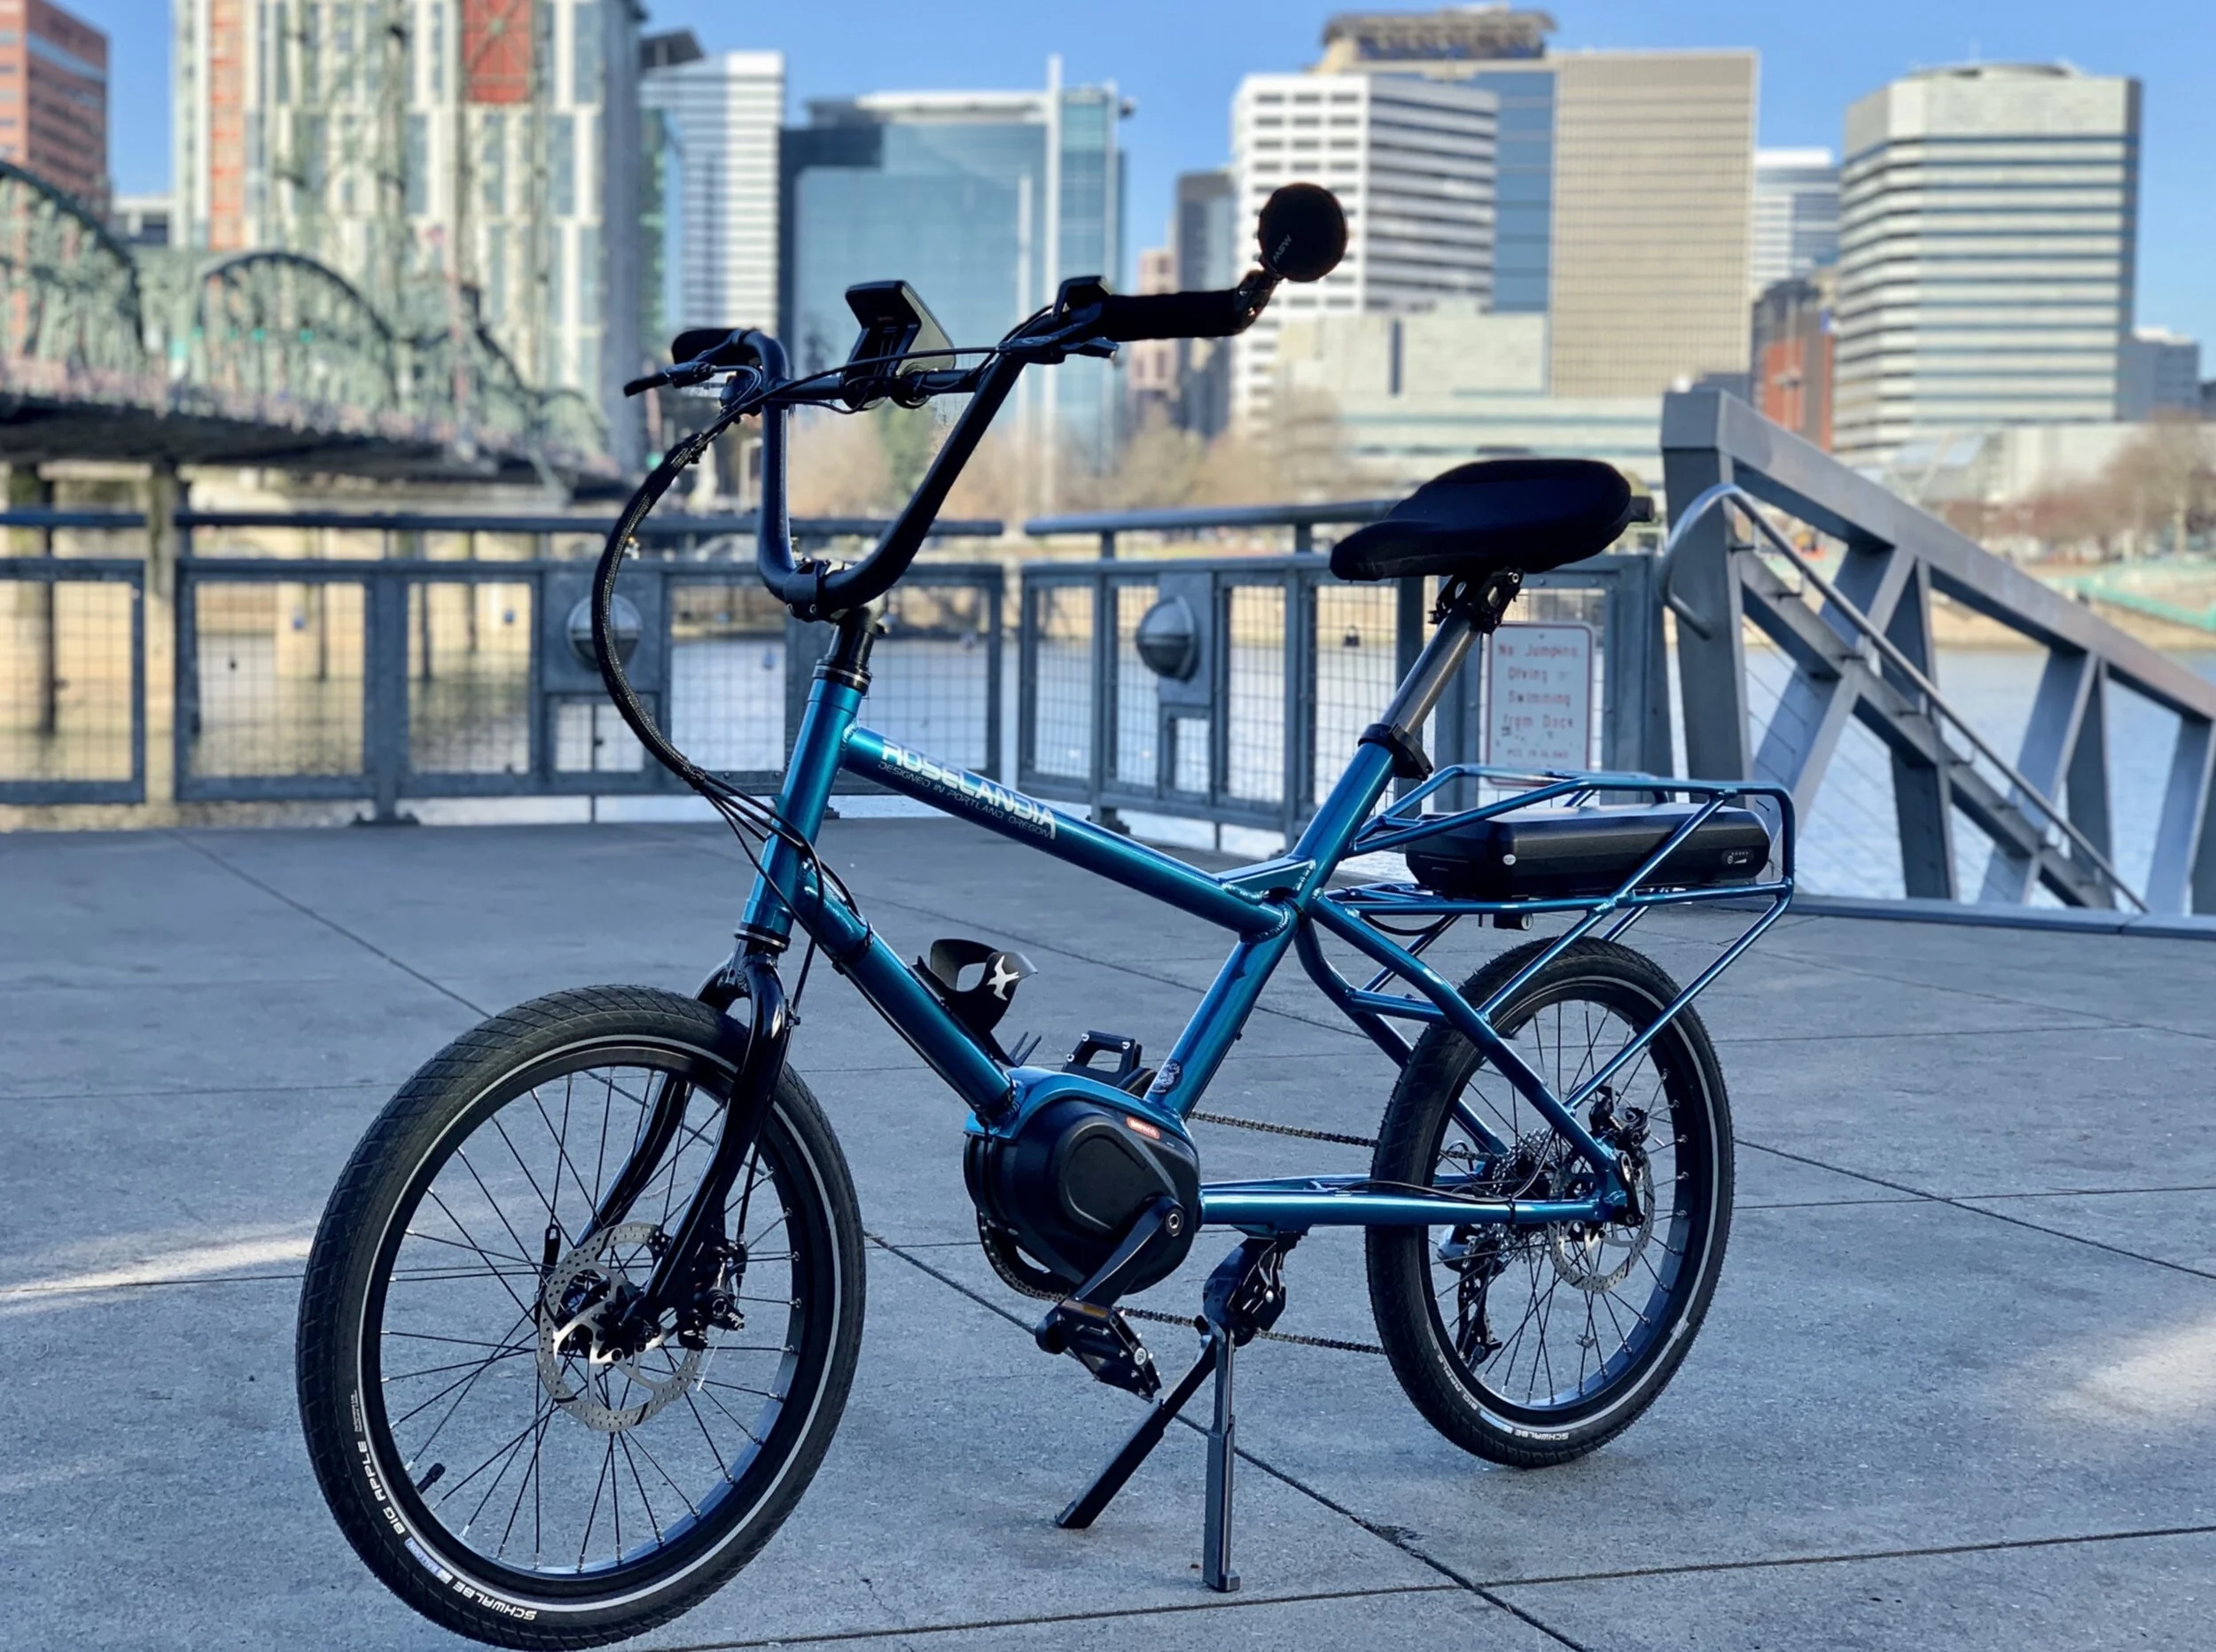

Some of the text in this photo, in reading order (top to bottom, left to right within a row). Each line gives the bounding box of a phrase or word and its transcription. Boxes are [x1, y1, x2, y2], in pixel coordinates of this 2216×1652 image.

[1498, 643, 1578, 658] No Jumping
[1508, 666, 1548, 683] Diving
[1508, 689, 1572, 708] Swimming
[1503, 713, 1573, 729] from Dock
[881, 737, 1056, 840] ROSELANDIA
[878, 760, 931, 788] DESIGNED
[933, 783, 946, 793] IN
[1008, 814, 1049, 838] OREGON
[1462, 1392, 1478, 1411] BIG
[1514, 1429, 1570, 1441] SCHWALBE
[357, 1440, 386, 1502] APPLE
[383, 1507, 405, 1534] BIG
[453, 1580, 537, 1621] SCHWALBE
